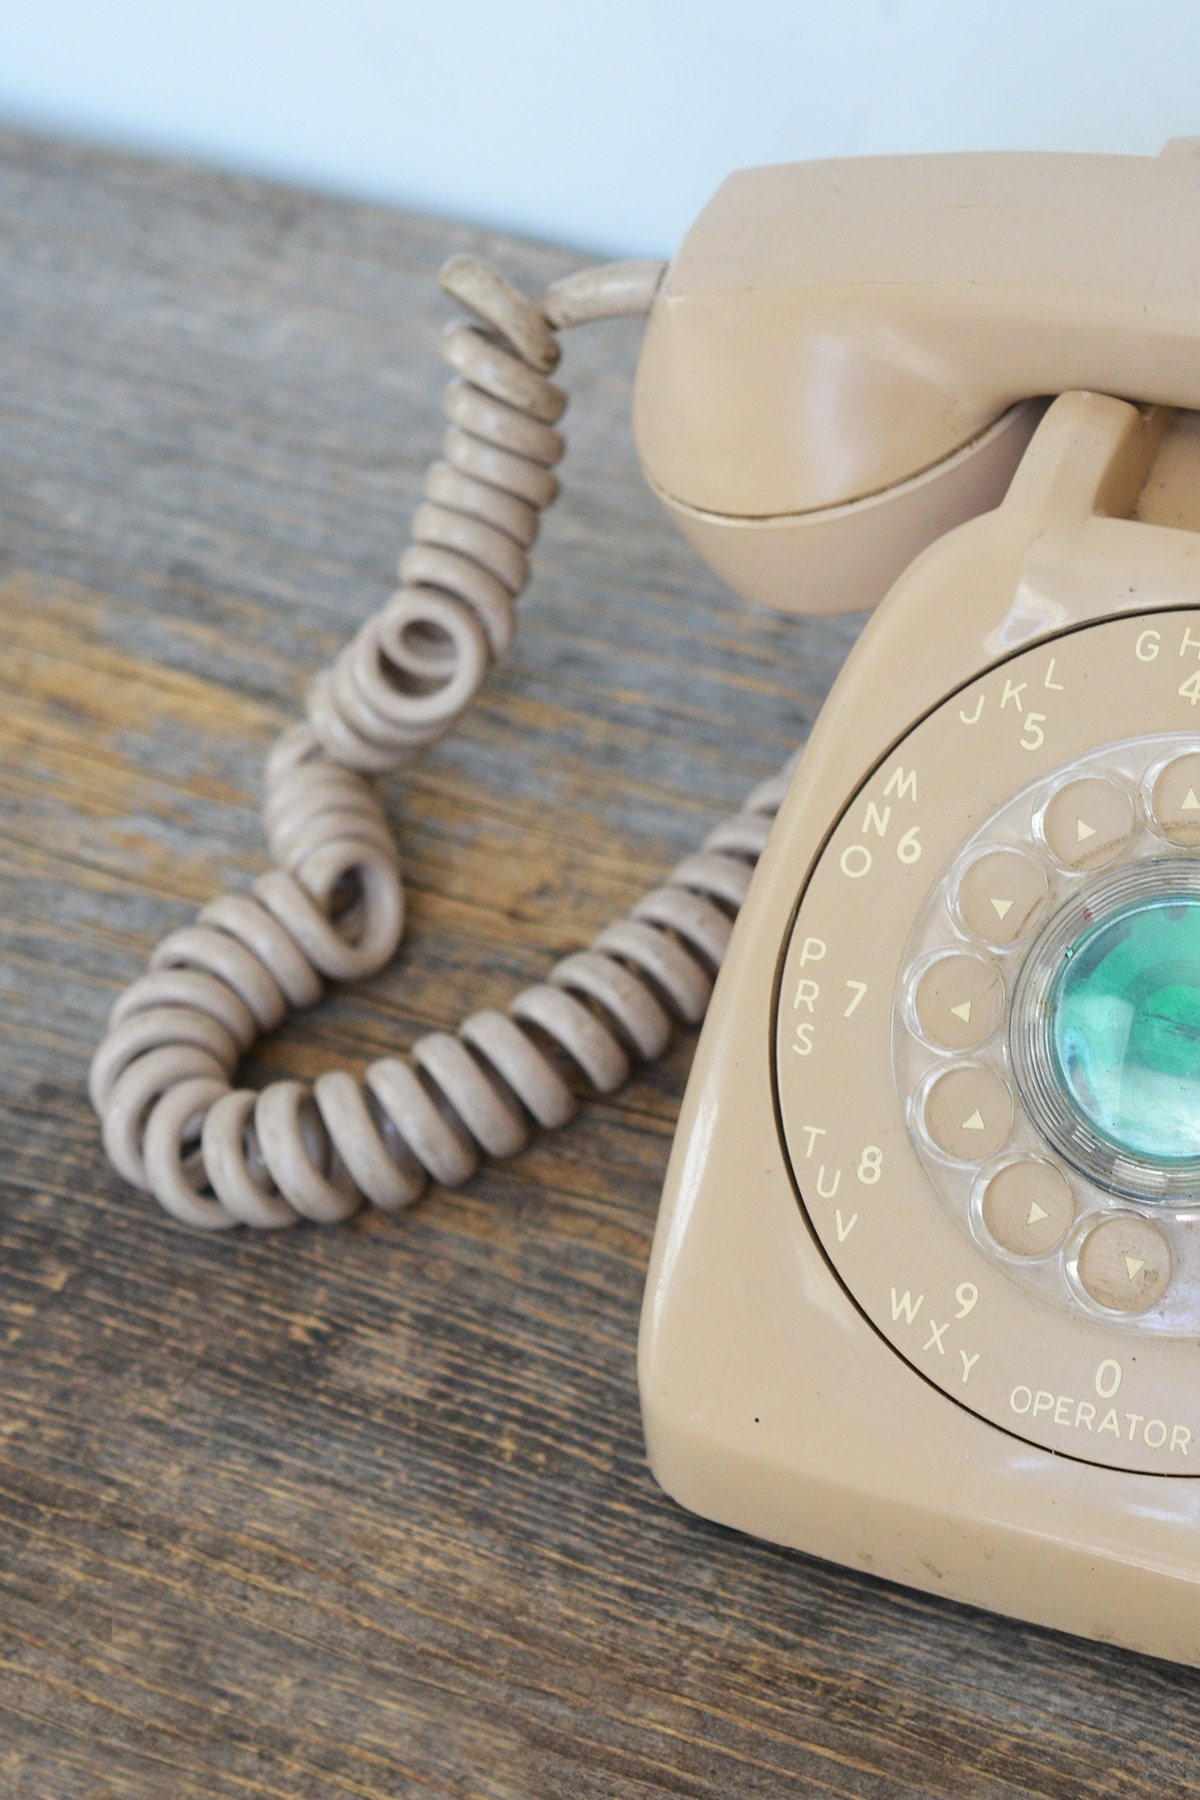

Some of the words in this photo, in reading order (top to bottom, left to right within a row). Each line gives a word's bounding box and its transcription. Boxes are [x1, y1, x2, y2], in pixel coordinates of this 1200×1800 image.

[1019, 712, 1047, 751] 5
[896, 826, 922, 864] 6
[842, 980, 868, 1018] 7
[856, 1145, 883, 1185] 8
[953, 1281, 979, 1319] 9
[1094, 1358, 1123, 1399] 0
[1009, 1384, 1192, 1456] OPERATOR
